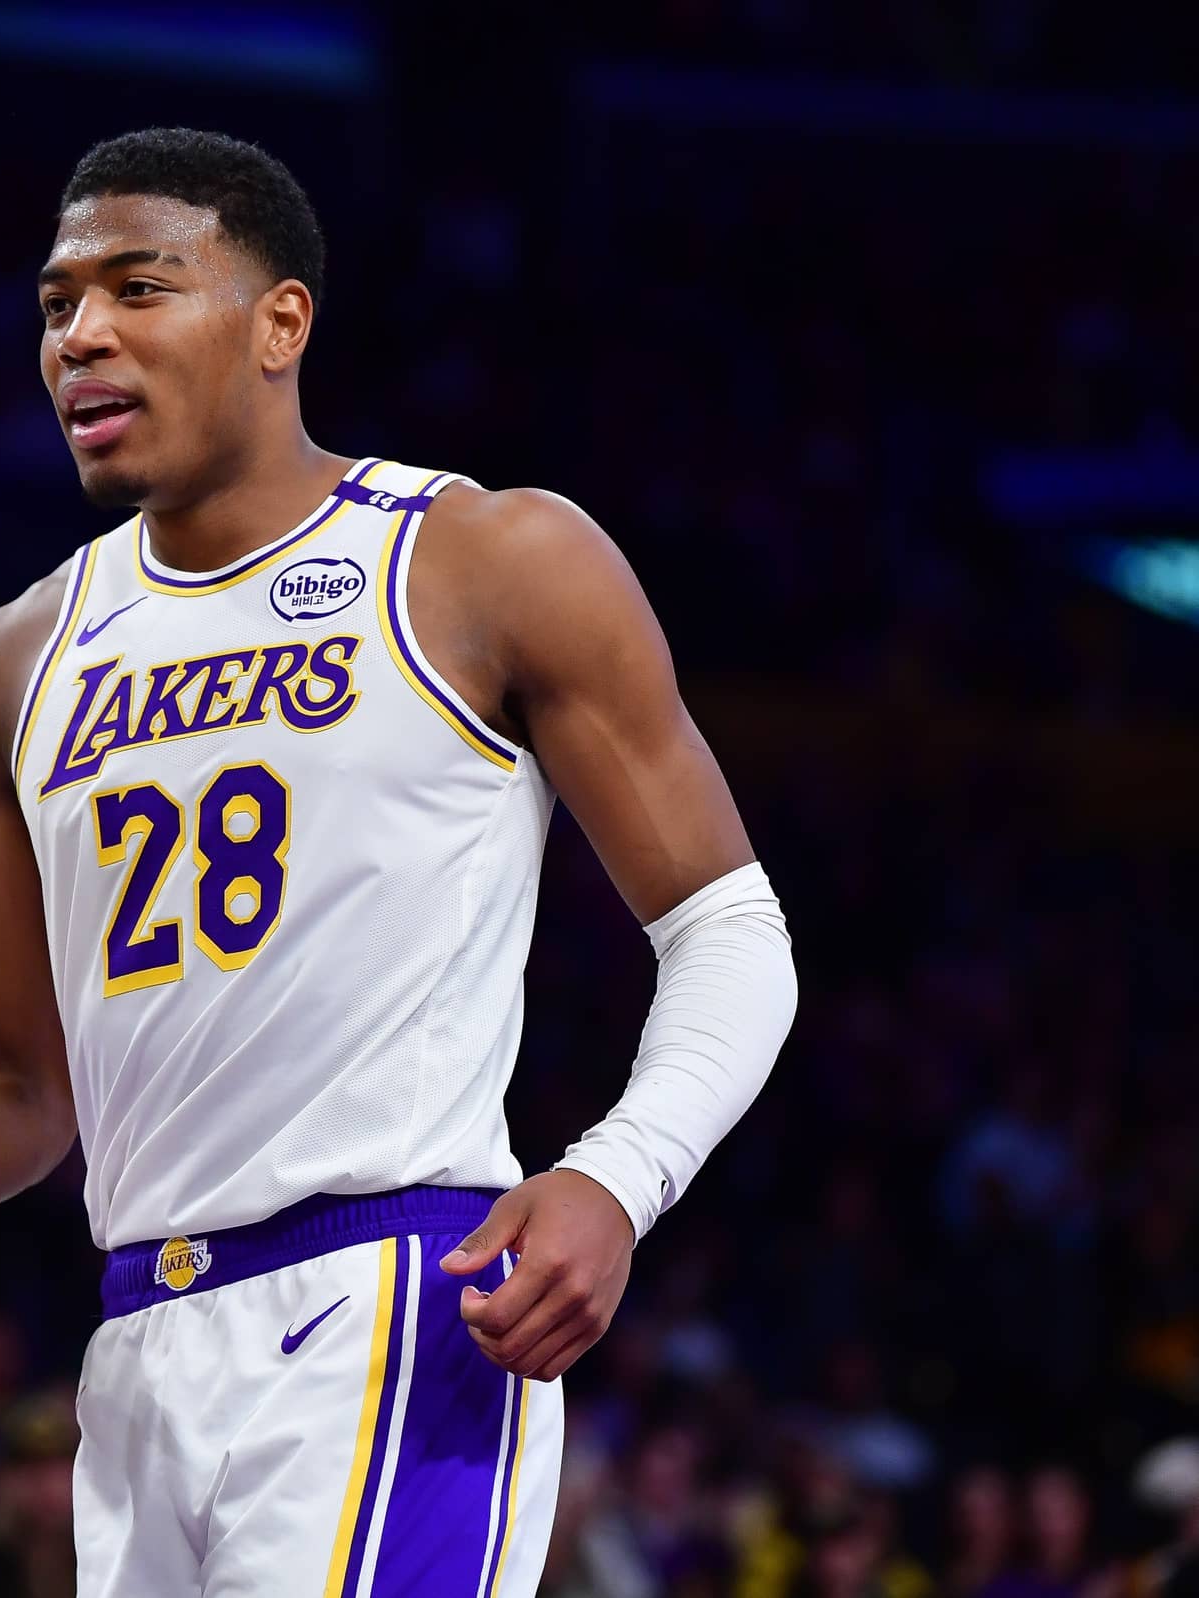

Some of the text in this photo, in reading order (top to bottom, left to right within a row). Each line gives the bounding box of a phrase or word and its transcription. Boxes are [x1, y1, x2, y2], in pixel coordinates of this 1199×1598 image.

[368, 491, 398, 510] 44
[280, 574, 360, 599] bibigo
[291, 595, 324, 607] 비비고
[38, 632, 365, 804] LAKERS
[89, 759, 292, 999] 28
[155, 1249, 210, 1283] LAKERS
